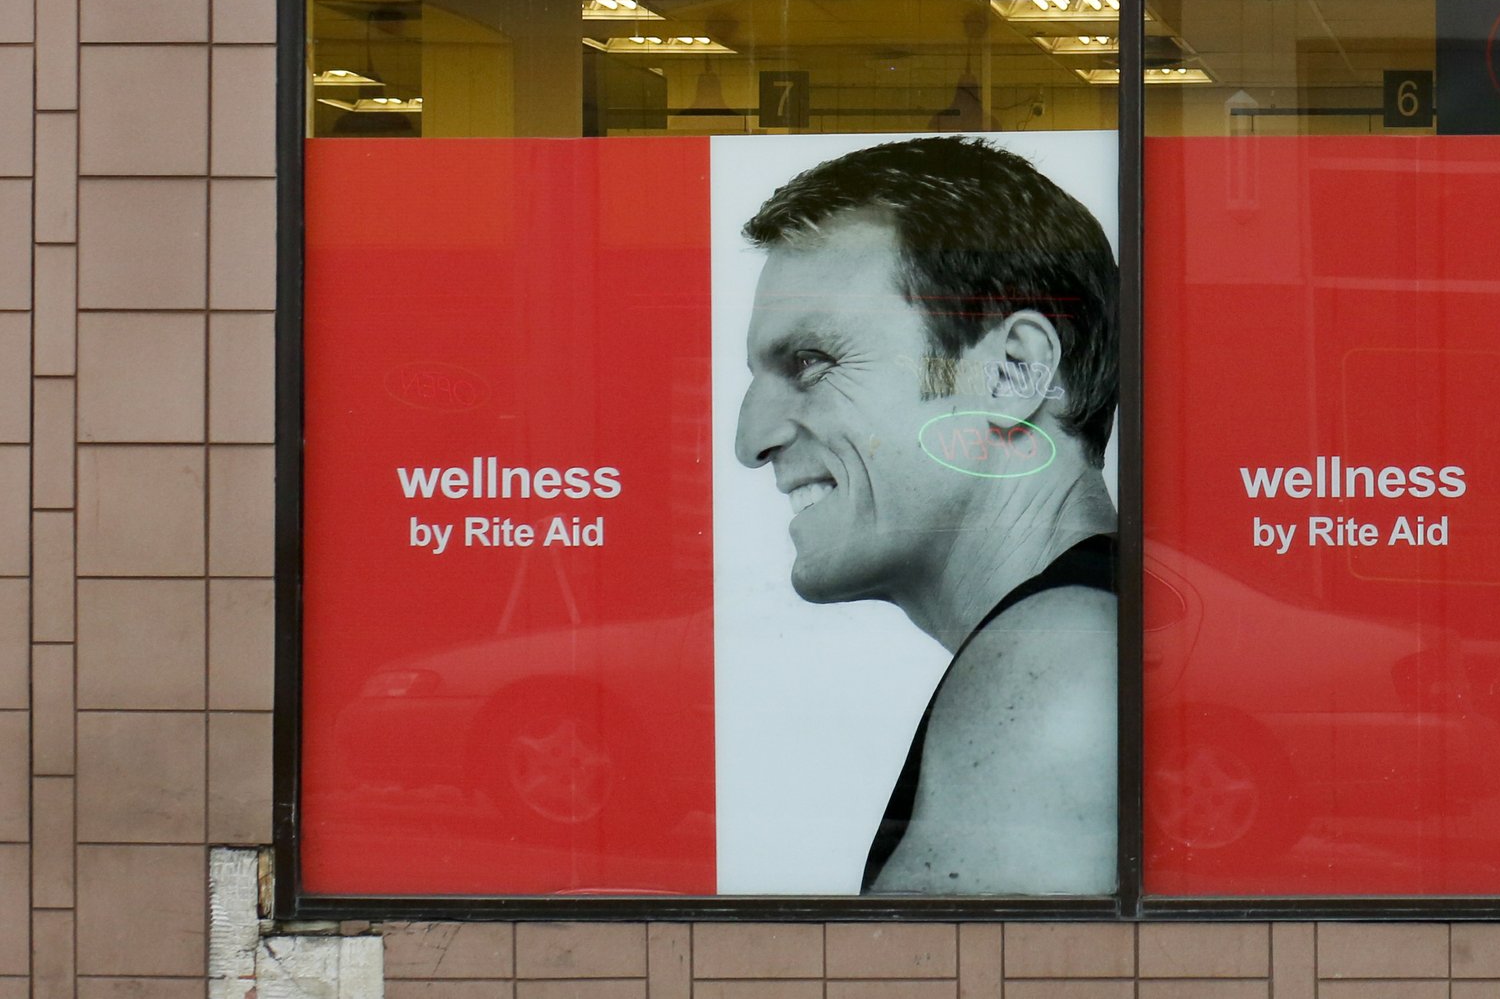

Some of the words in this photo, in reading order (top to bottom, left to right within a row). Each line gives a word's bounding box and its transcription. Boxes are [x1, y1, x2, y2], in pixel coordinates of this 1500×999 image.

[773, 81, 794, 117] 7
[1397, 80, 1419, 117] 6
[396, 457, 622, 499] wellness
[1239, 456, 1467, 499] wellness
[411, 517, 453, 554] by
[464, 516, 534, 547] Rite
[543, 516, 604, 547] Aid
[1253, 517, 1297, 554] by
[1309, 516, 1378, 547] Rite
[1387, 516, 1449, 547] Aid
